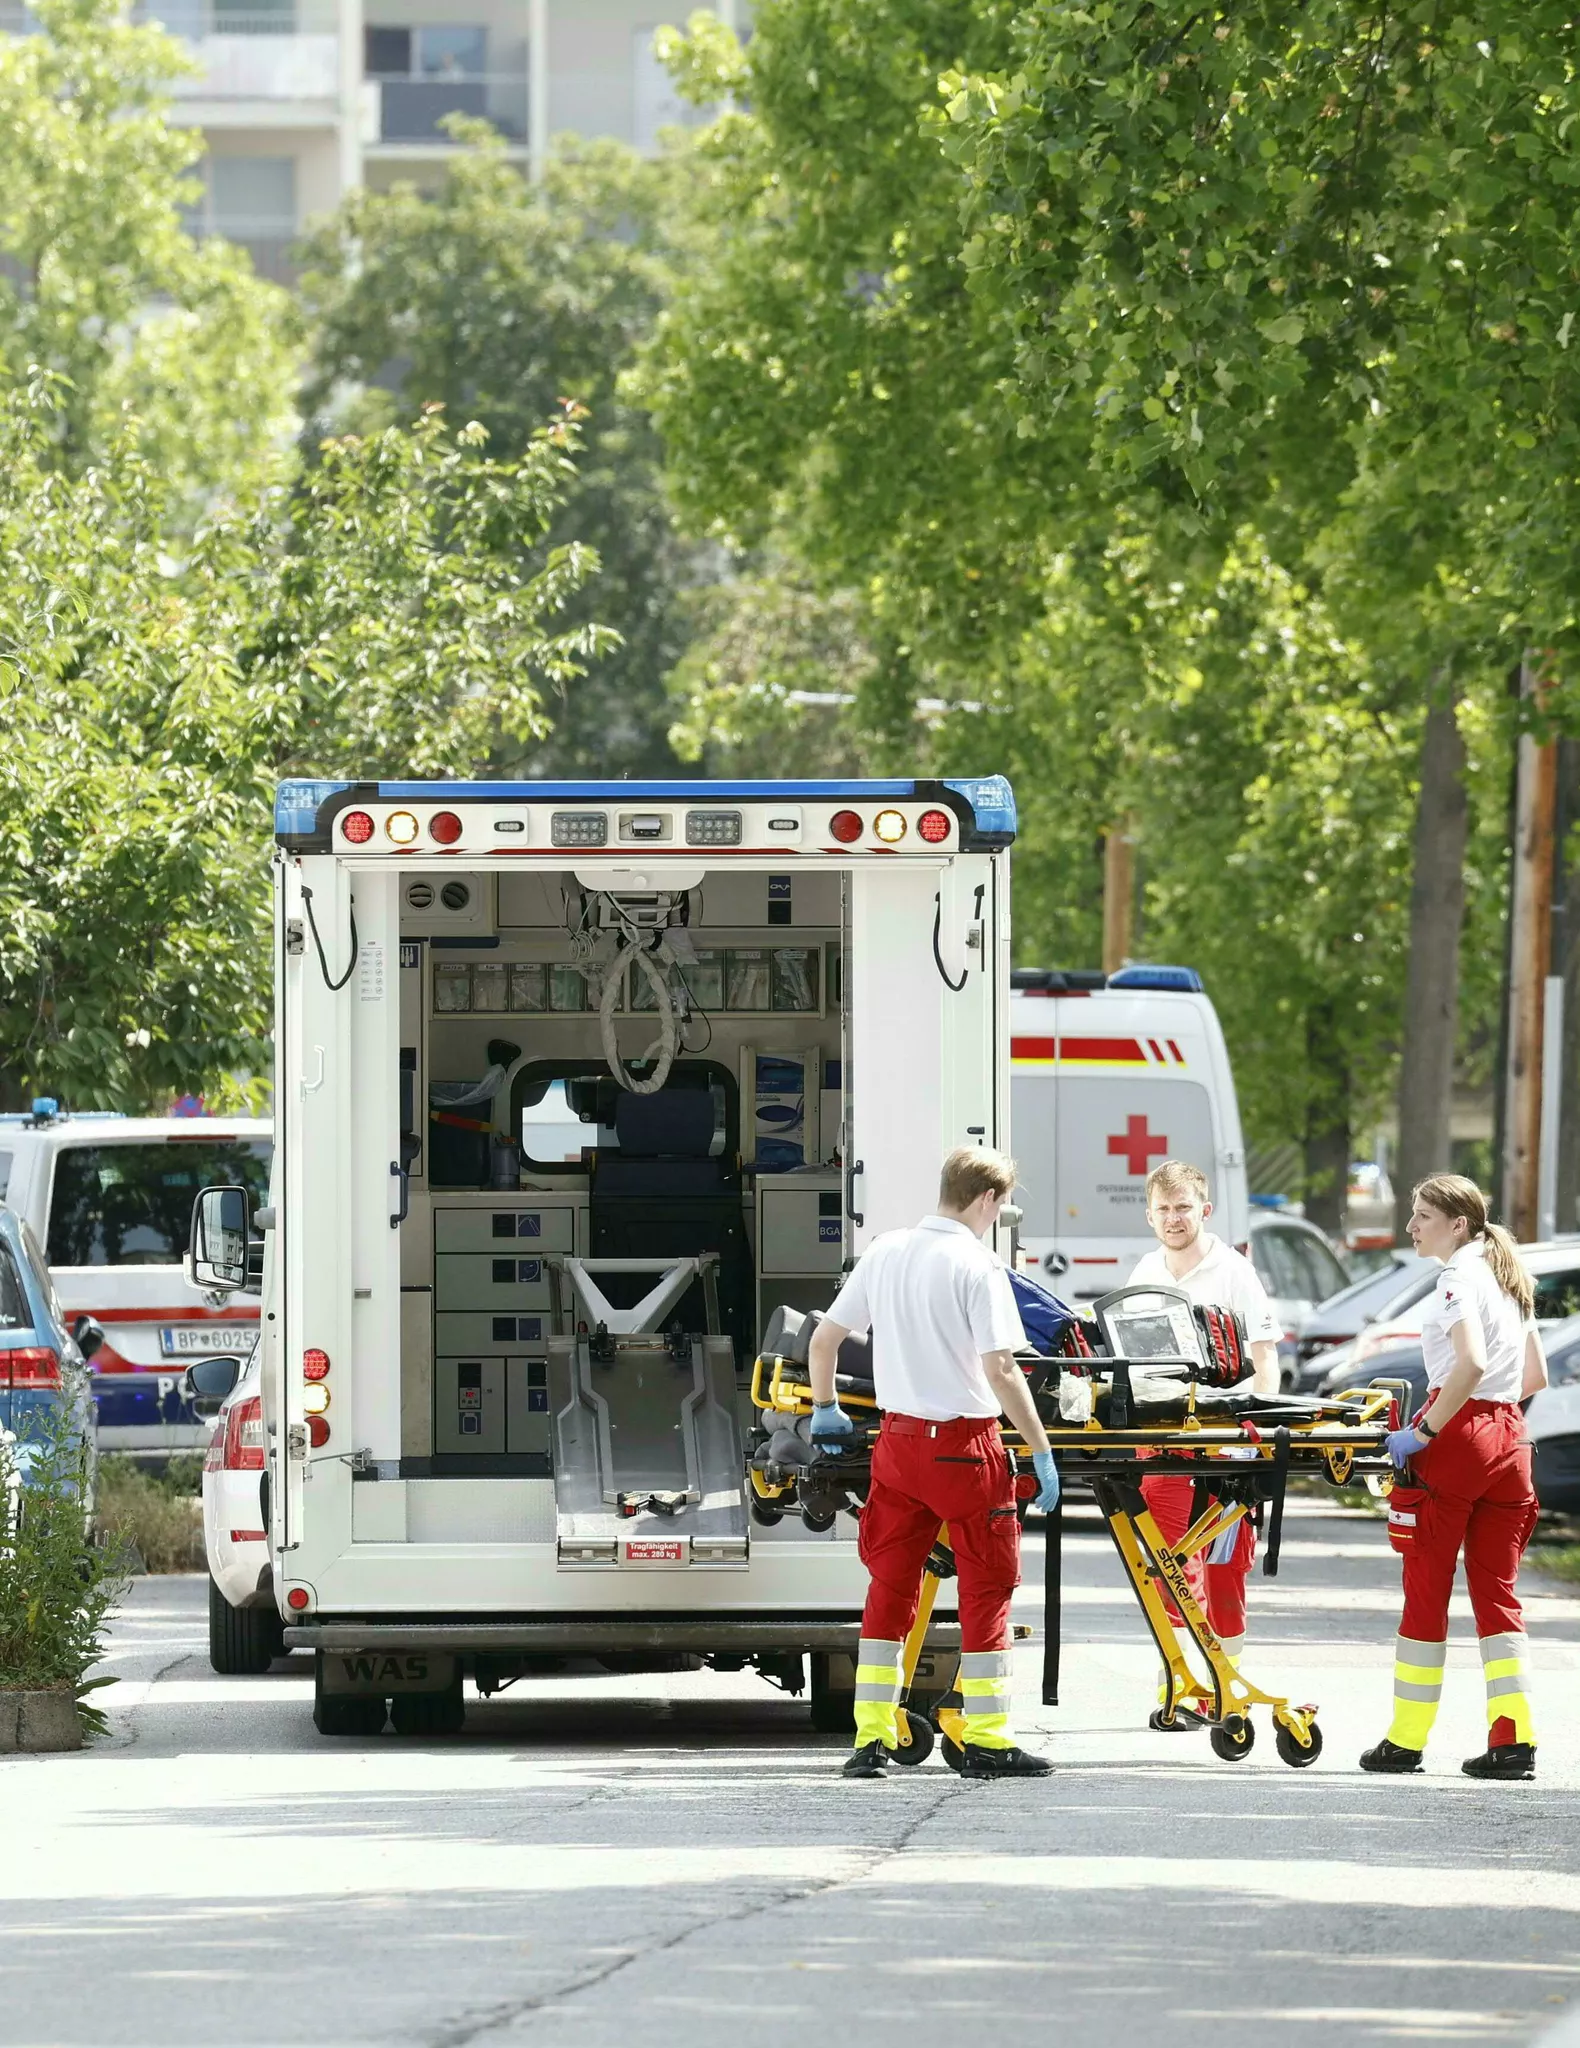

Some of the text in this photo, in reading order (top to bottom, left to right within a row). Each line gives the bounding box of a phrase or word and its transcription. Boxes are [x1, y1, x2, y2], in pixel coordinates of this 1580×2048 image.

[820, 1226, 840, 1236] BGA
[629, 1542, 678, 1551] Tragfähigkeit
[651, 1550, 665, 1558] 280
[666, 1550, 676, 1559] kg
[1156, 1547, 1195, 1603] stryker
[341, 1657, 428, 1681] WAS
